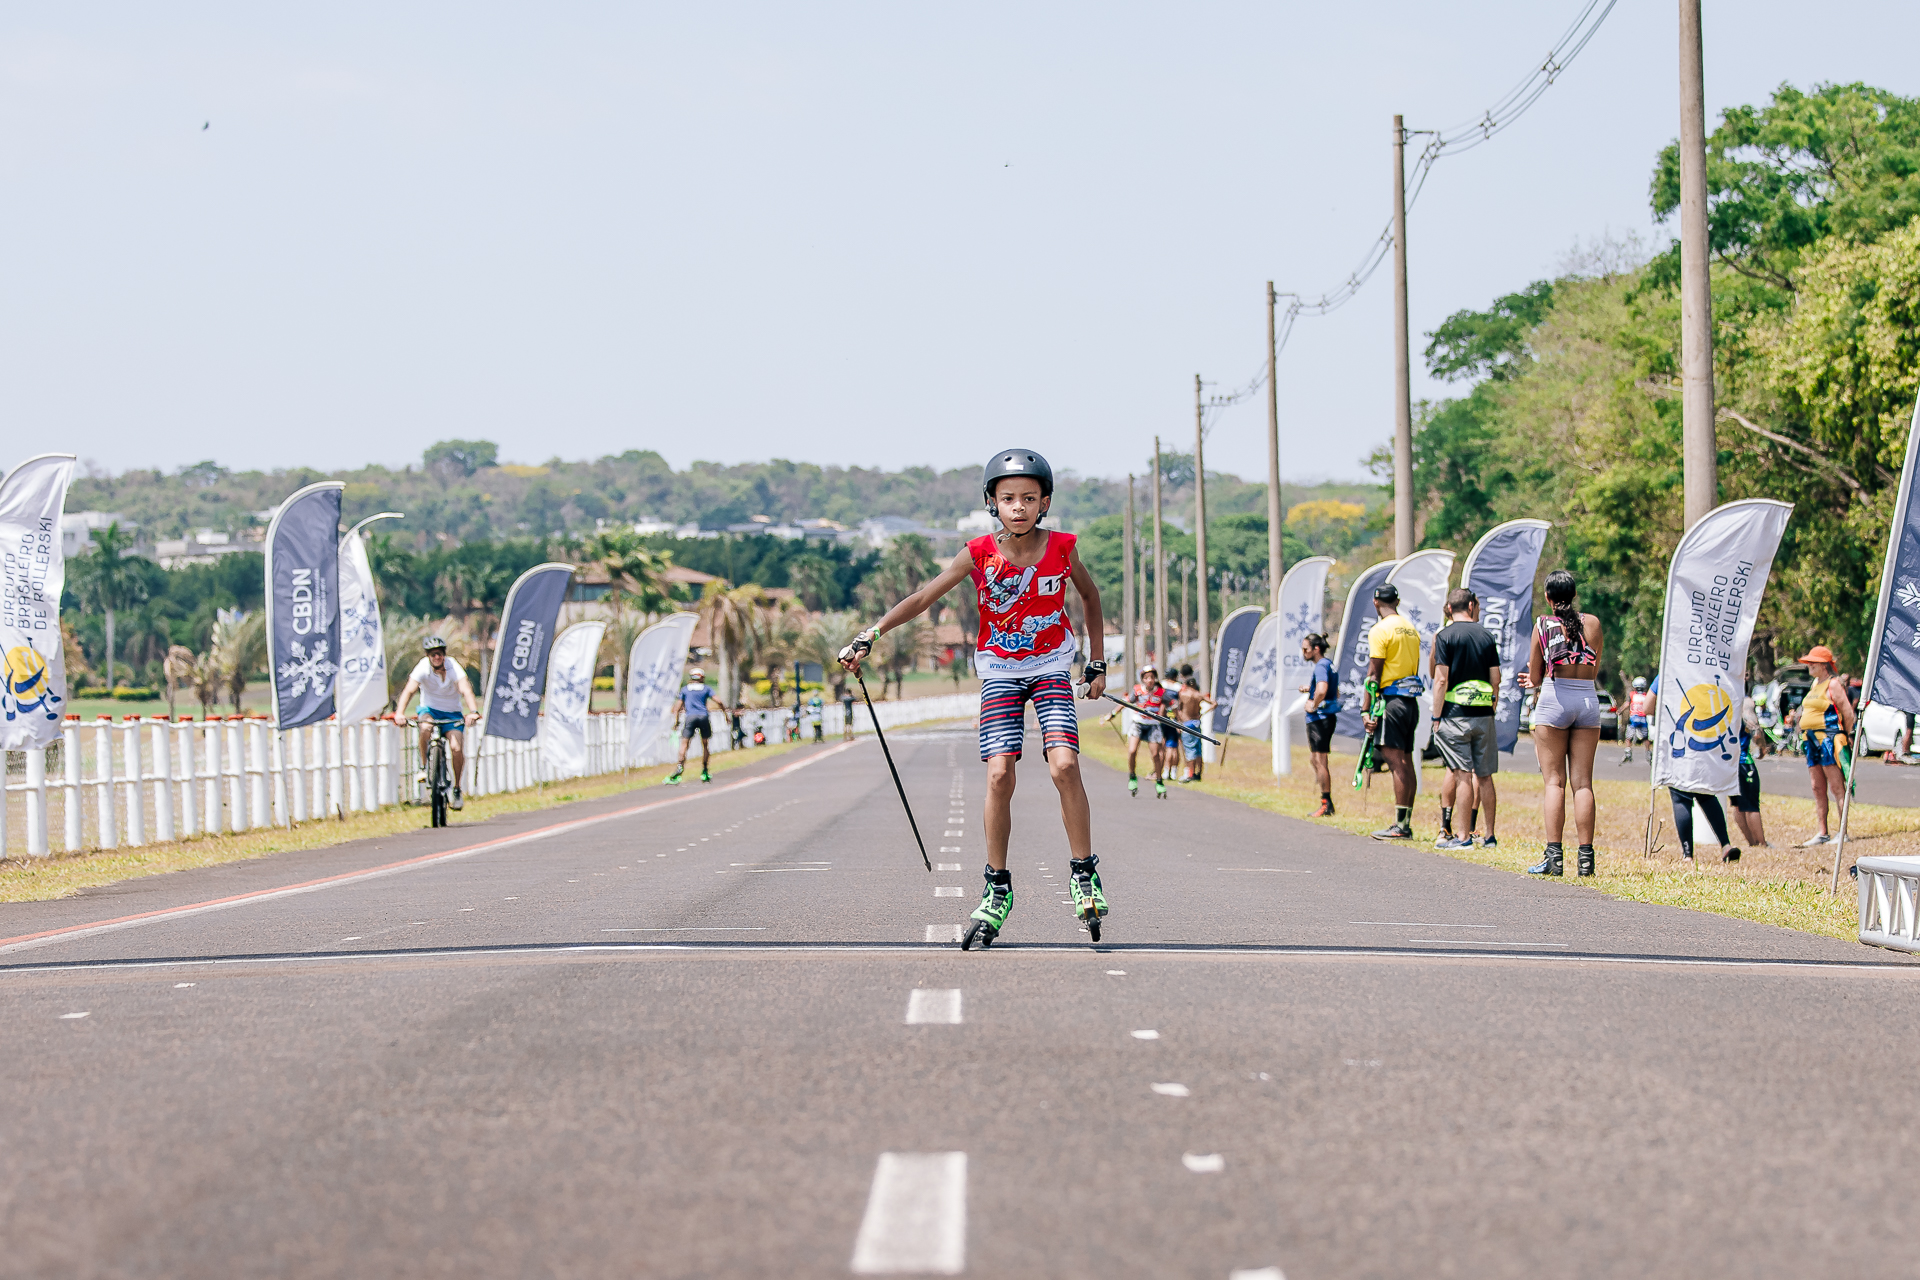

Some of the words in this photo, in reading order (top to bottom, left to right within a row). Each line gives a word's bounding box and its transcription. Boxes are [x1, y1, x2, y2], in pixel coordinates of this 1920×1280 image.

[4, 552, 15, 627] CIRCUITO
[18, 533, 34, 629] BRASILEIRO
[32, 517, 52, 602] ROLLERSKI
[34, 610, 47, 630] DE
[292, 568, 312, 635] CBDN
[1687, 590, 1706, 664] CIRCUITO
[1705, 575, 1728, 667] BRASILEIRO
[1721, 560, 1753, 647] ROLLERSKI
[511, 619, 537, 671] CBDN
[1718, 650, 1731, 671] DE
